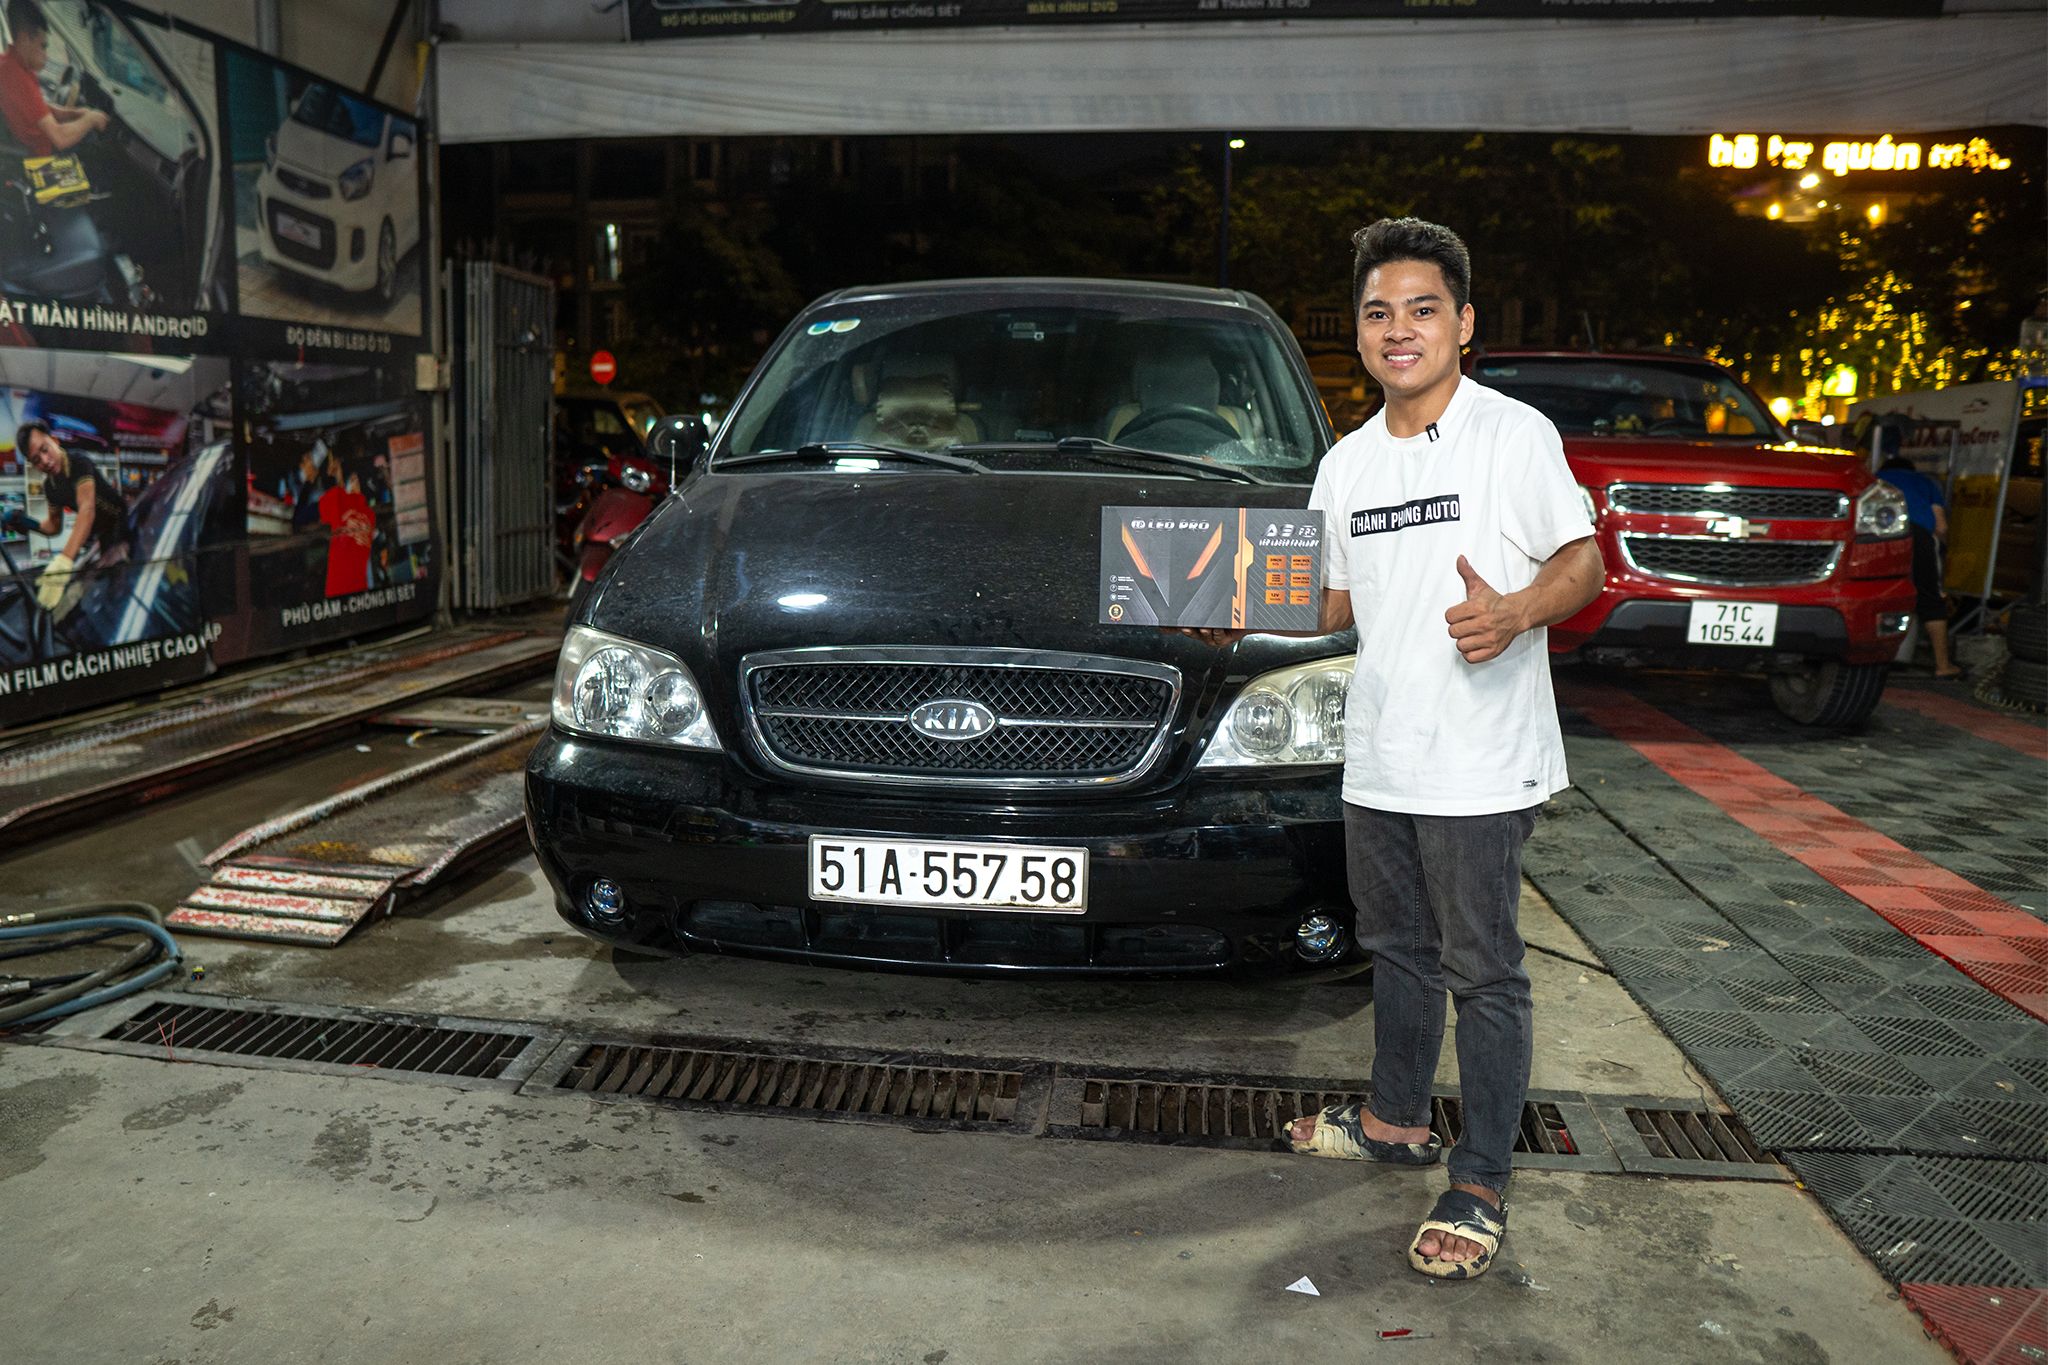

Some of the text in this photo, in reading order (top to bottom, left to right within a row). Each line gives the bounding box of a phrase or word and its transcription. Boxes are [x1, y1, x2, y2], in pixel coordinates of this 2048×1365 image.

[1822, 133, 1921, 177] quán
[32, 300, 78, 328] MÀN
[82, 304, 129, 333] HÌNH
[131, 314, 209, 339] ANDROID
[1178, 519, 1210, 532] PRO
[1351, 512, 1387, 534] THÀNH
[1425, 500, 1460, 521] AUTO
[1717, 604, 1753, 622] 71C
[1701, 624, 1764, 643] 105.44
[14, 662, 60, 693] FILM
[60, 652, 112, 682] CÁCH
[113, 641, 161, 668] NHIỆT
[163, 633, 199, 660] CAO
[924, 707, 983, 731] KIA
[820, 845, 1077, 904] 51A-557.58
